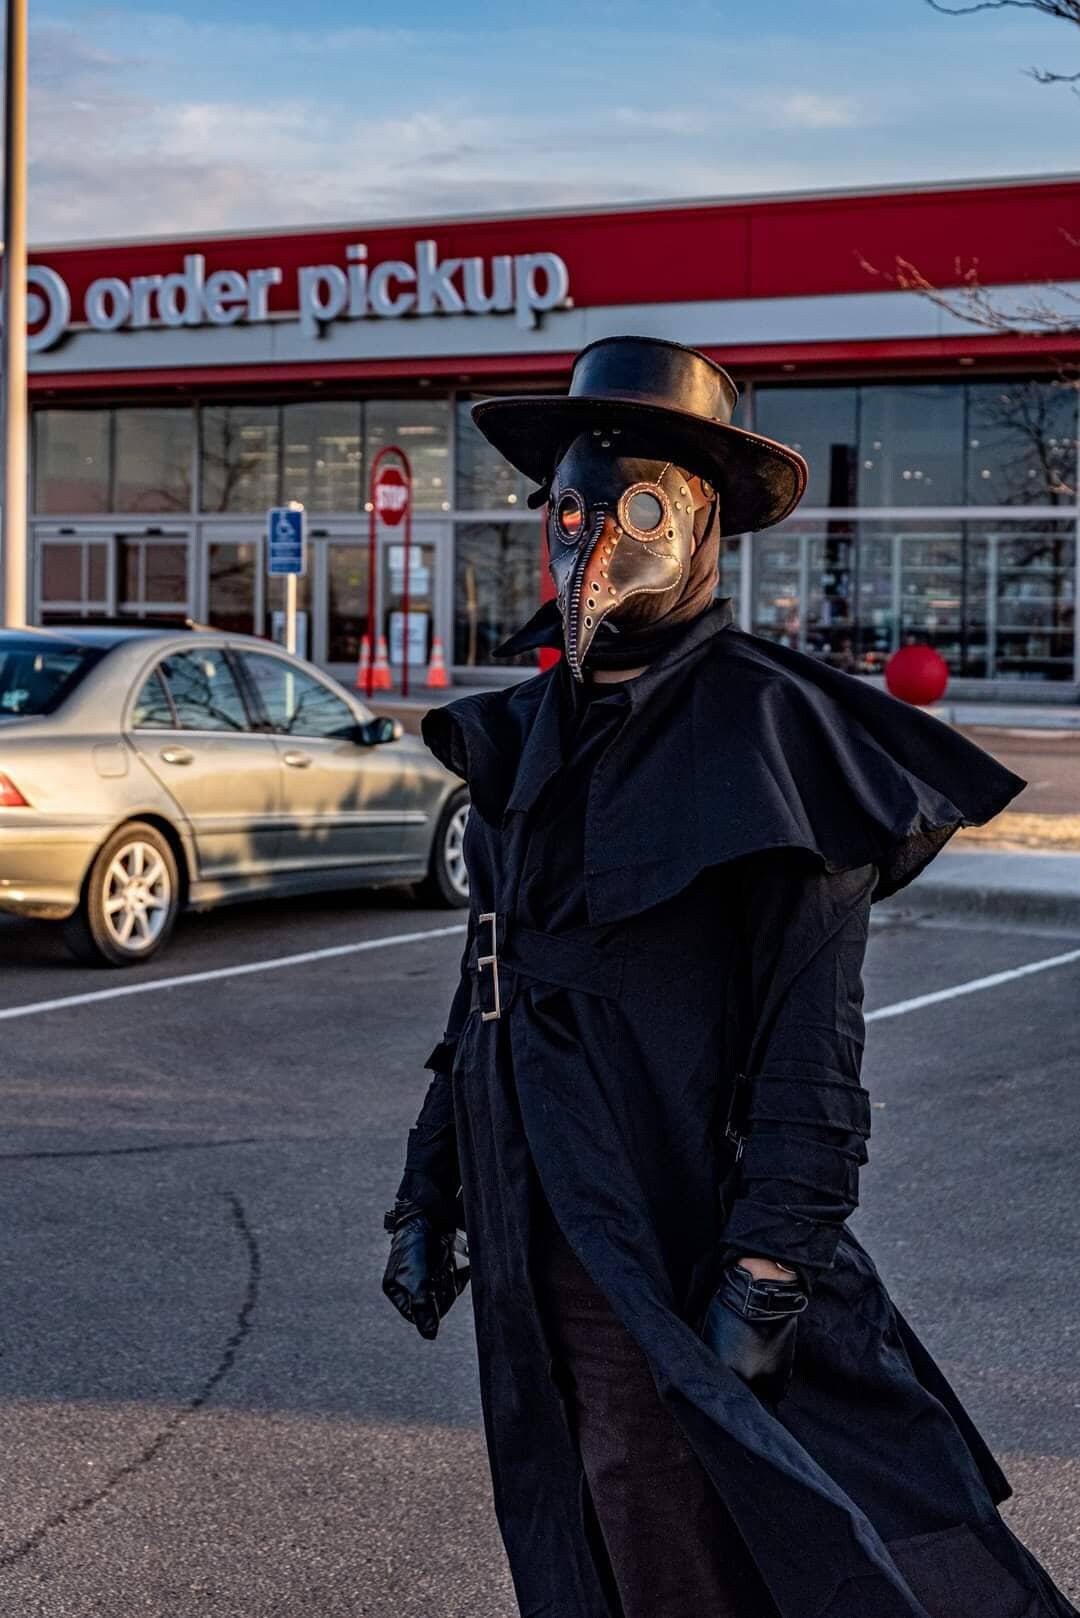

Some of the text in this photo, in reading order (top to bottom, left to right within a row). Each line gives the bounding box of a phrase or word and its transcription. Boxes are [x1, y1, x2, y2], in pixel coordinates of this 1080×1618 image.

[84, 239, 570, 337] order pickup
[376, 485, 408, 511] STOP
